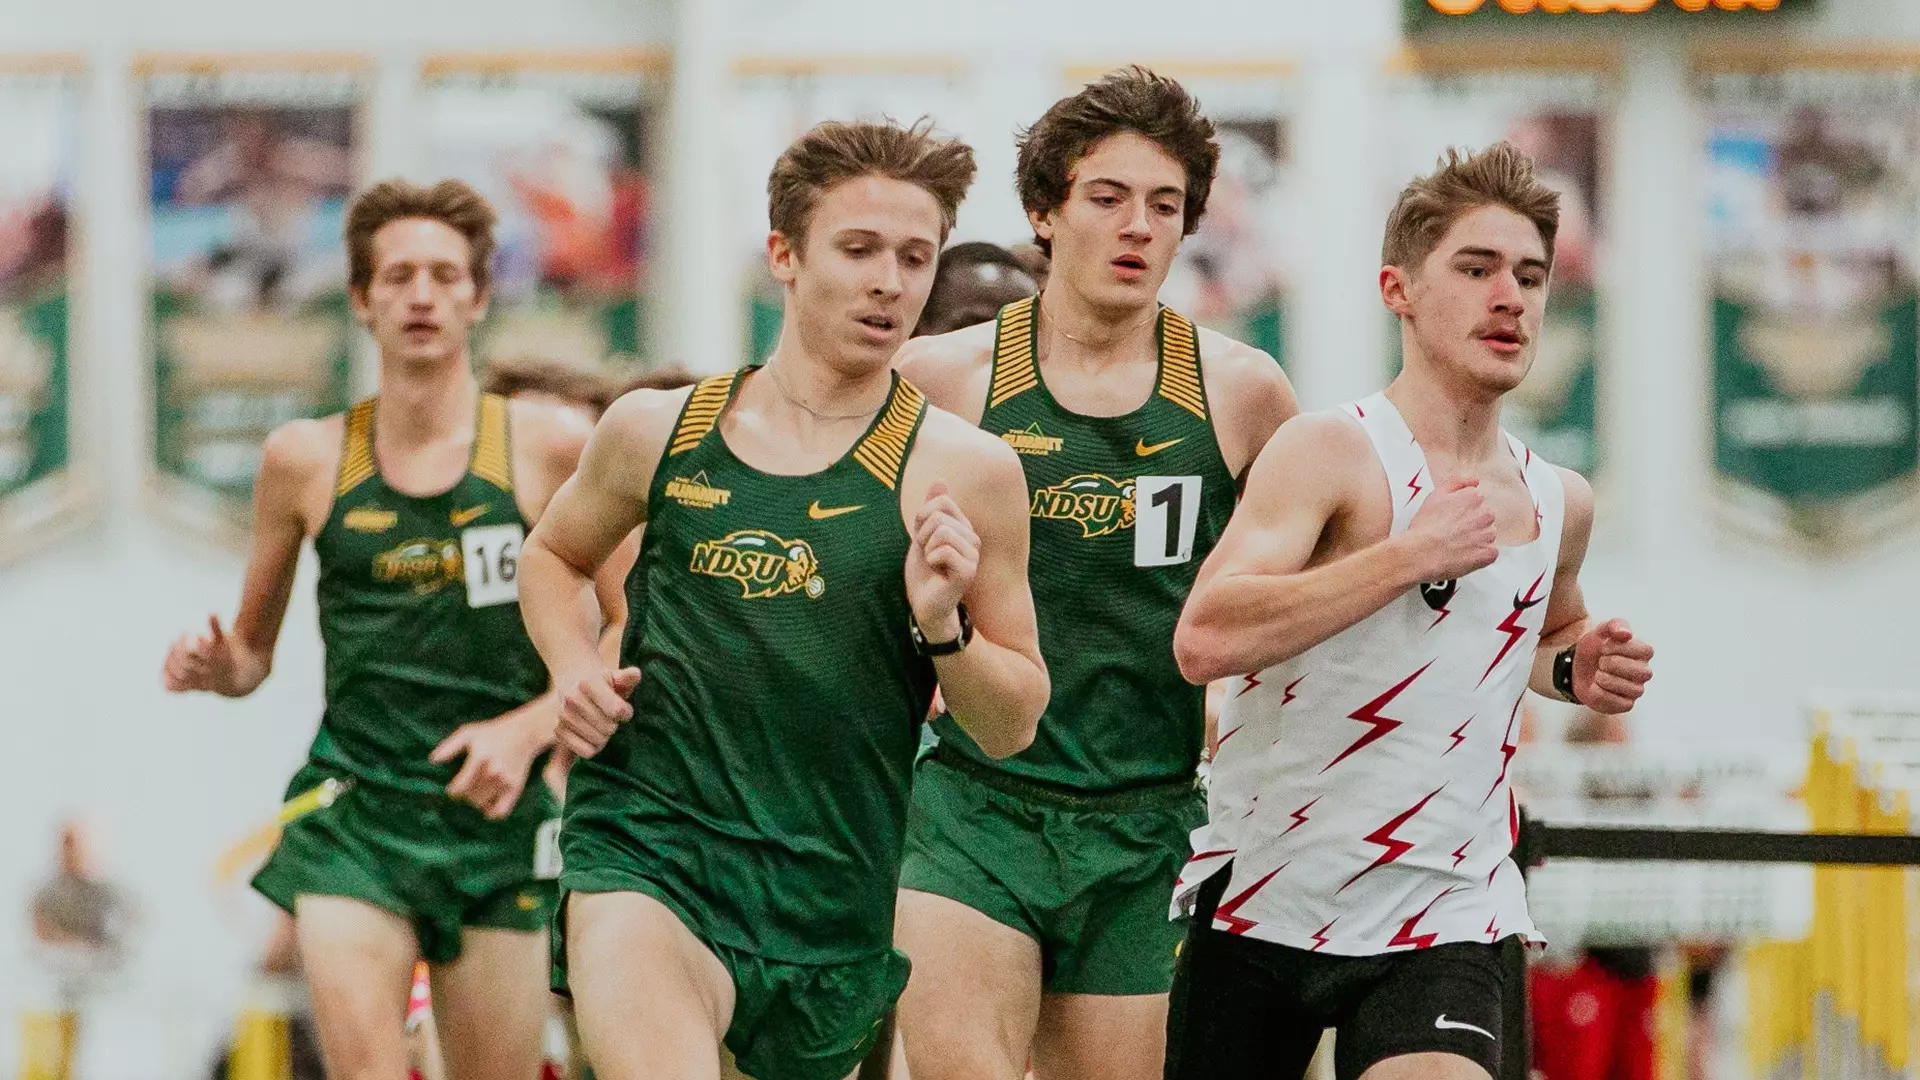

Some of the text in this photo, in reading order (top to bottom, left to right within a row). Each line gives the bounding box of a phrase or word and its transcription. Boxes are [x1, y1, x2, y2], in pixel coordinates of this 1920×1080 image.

[1030, 489, 1120, 522] NDSU
[1152, 483, 1183, 558] 1
[476, 541, 517, 585] 16
[690, 542, 787, 584] NDSU
